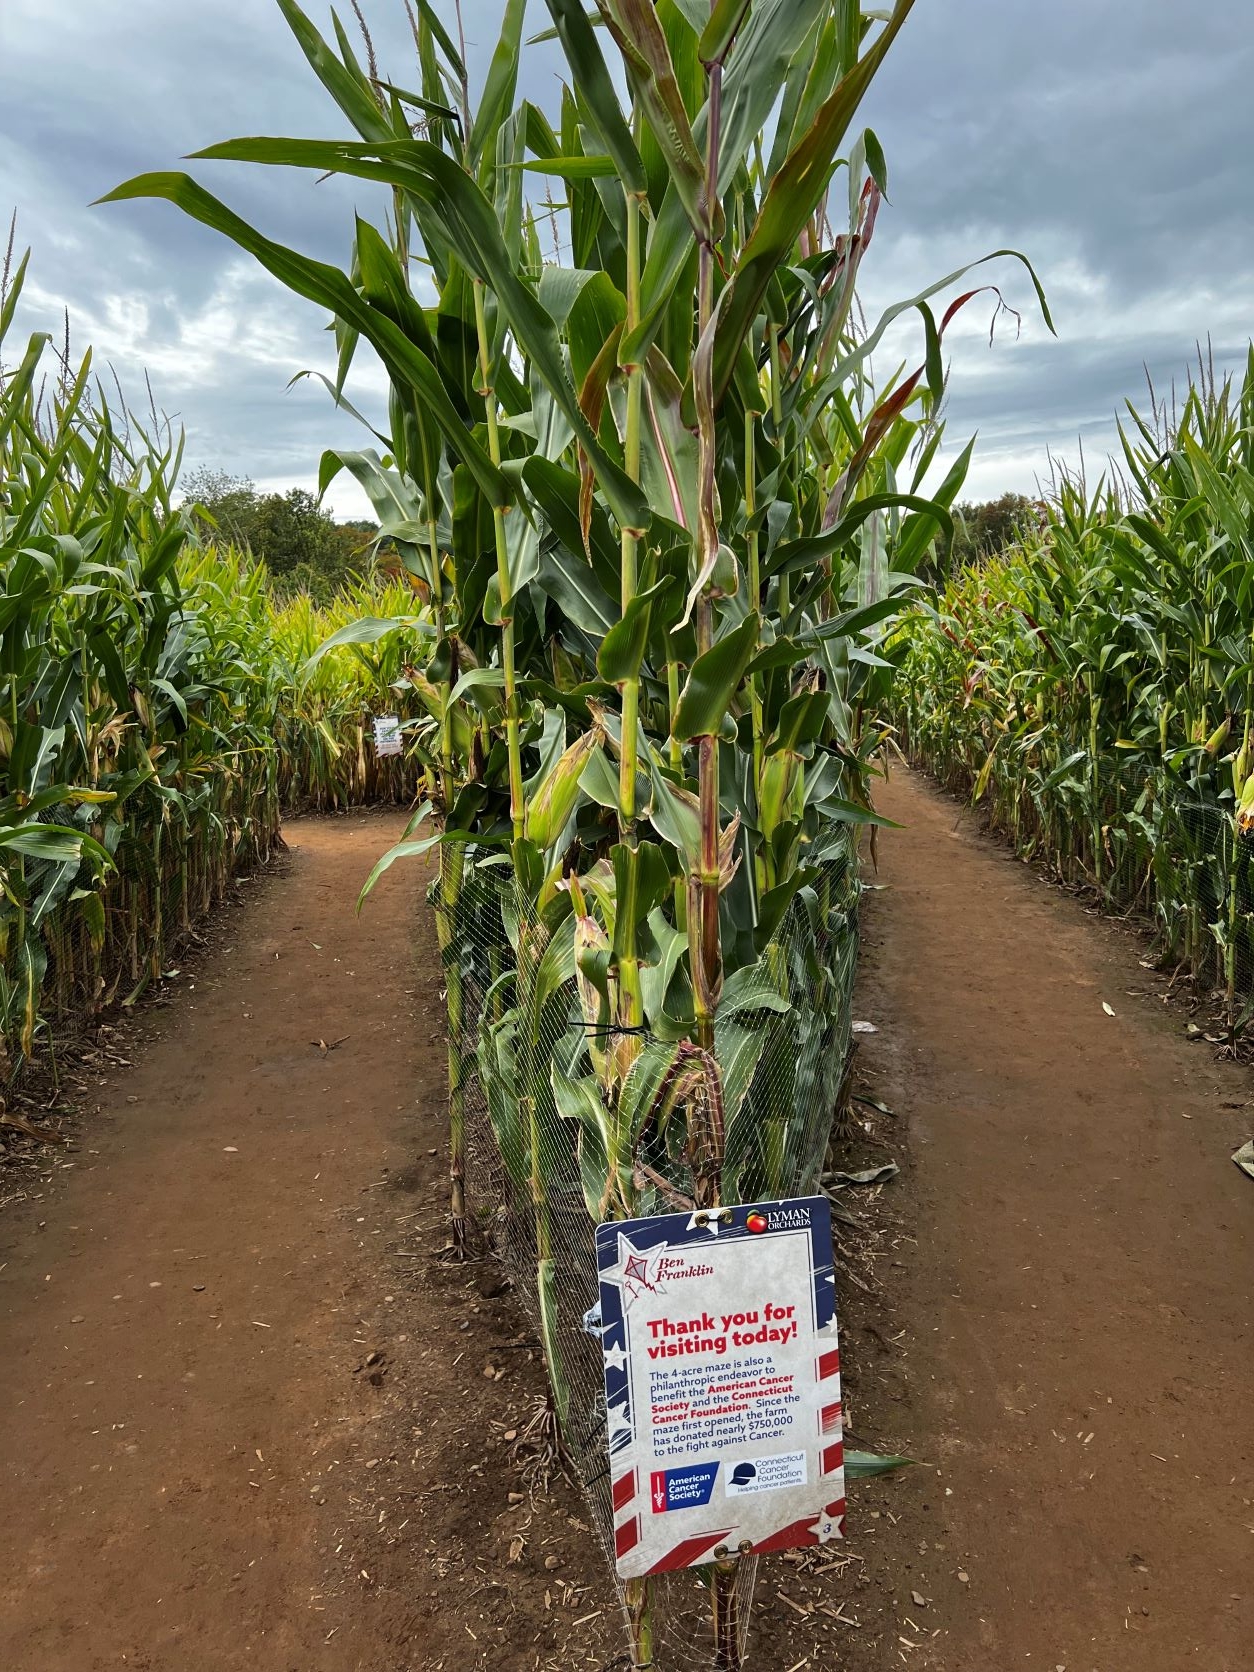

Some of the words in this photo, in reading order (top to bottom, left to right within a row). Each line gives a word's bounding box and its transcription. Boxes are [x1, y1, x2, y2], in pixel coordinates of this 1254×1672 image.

[767, 1208, 810, 1222] LYMAN
[768, 1219, 811, 1230] ORCHARDS
[657, 1258, 684, 1270] Ben
[655, 1266, 714, 1282] Franklin
[647, 1313, 715, 1338] Thank
[721, 1311, 758, 1332] you
[764, 1303, 795, 1321] for
[647, 1335, 726, 1359] visiting
[732, 1321, 797, 1346] today!
[650, 1372, 668, 1381] The
[671, 1368, 702, 1377] 4-acre
[705, 1363, 731, 1373] maze
[734, 1360, 741, 1368] is
[744, 1357, 764, 1366] also
[650, 1375, 715, 1392] philanthropic
[718, 1368, 762, 1381] endeavor
[651, 1390, 686, 1403] benefit
[689, 1388, 705, 1397] the
[708, 1380, 757, 1394] American
[759, 1375, 794, 1385] Cancer
[652, 1401, 690, 1413] Society
[693, 1398, 710, 1407] and
[713, 1396, 729, 1404] the
[732, 1385, 793, 1400] Connecticut
[652, 1414, 688, 1424] Cancer
[691, 1404, 750, 1418] Foundation.
[756, 1398, 781, 1408] Since
[784, 1395, 800, 1403] the
[653, 1425, 678, 1435] maze
[682, 1421, 701, 1430] first
[705, 1414, 744, 1428] opened,
[747, 1412, 762, 1420] the
[765, 1408, 787, 1417] farm
[654, 1436, 670, 1446] has
[674, 1427, 714, 1443] donated
[717, 1426, 746, 1436] nearly
[749, 1416, 792, 1430] $750,000
[668, 1445, 683, 1454] the
[686, 1441, 708, 1453] fight
[712, 1436, 746, 1449] against
[750, 1430, 784, 1441] Cancer.
[755, 1454, 804, 1467] Connecticut
[758, 1469, 802, 1483] Foundation
[759, 1464, 789, 1474] Cancer
[668, 1473, 710, 1487] American
[759, 1481, 778, 1490] cancer
[669, 1483, 699, 1494] Cancer
[823, 1524, 832, 1533] 3
